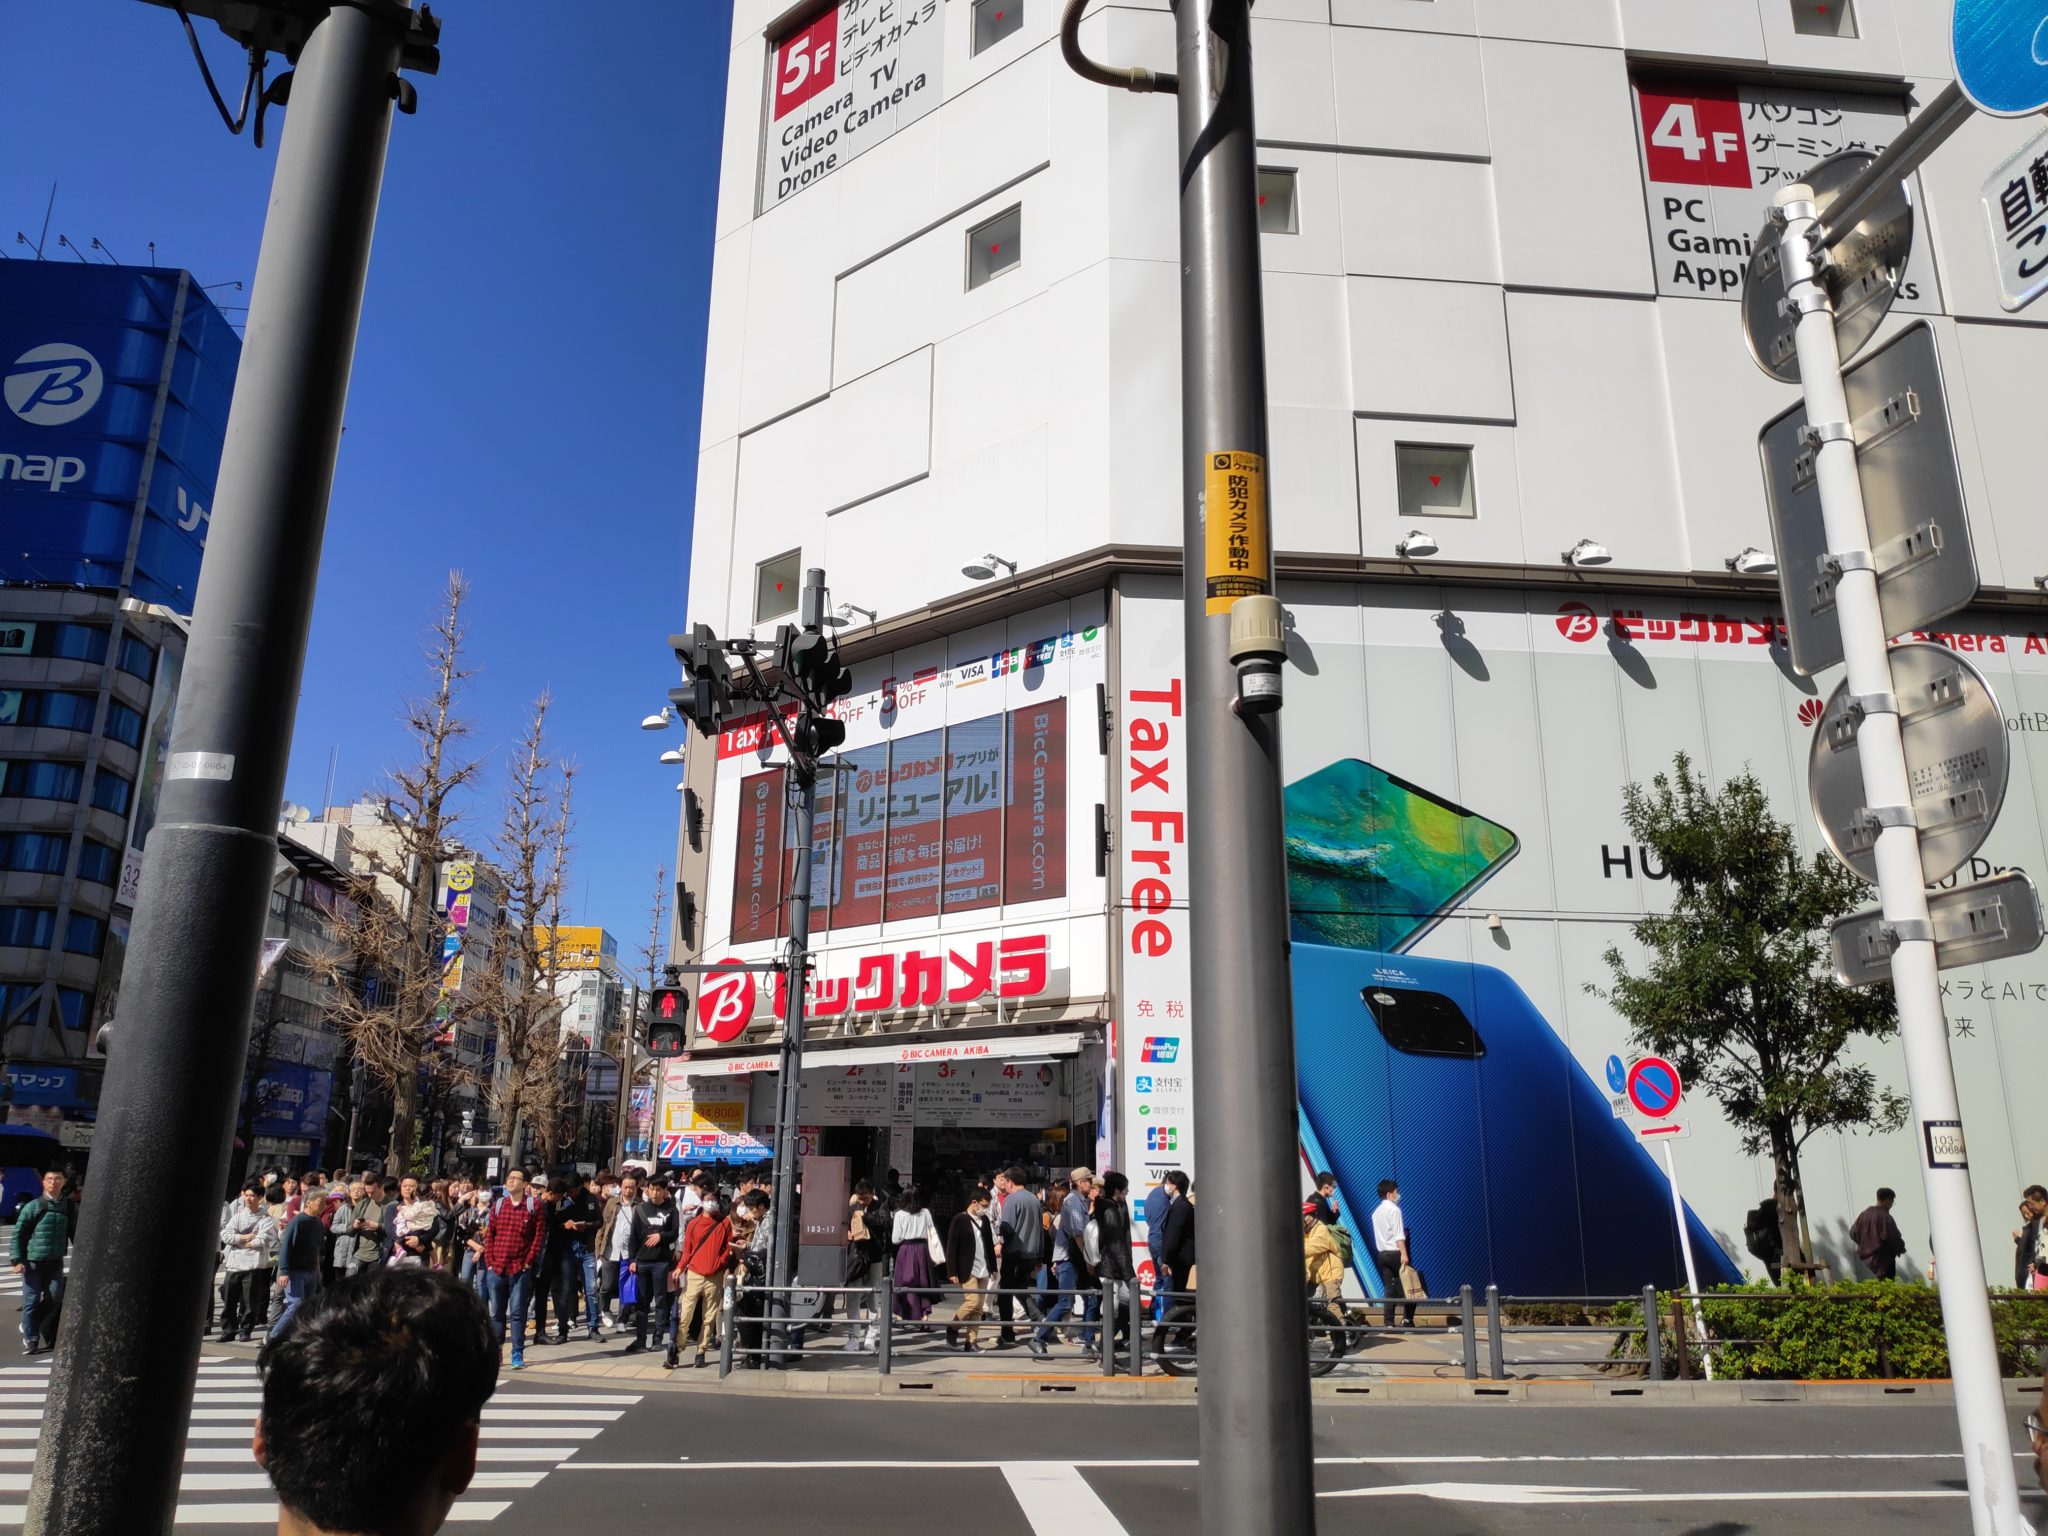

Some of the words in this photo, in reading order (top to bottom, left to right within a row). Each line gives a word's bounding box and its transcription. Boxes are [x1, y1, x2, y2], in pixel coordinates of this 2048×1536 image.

[840, 1, 936, 77] ビデオカメラ
[843, 1, 894, 48] テレビ
[781, 36, 831, 96] 5F
[781, 91, 854, 146] Camera
[870, 58, 897, 90] TV
[1747, 102, 1842, 127] パソコン
[781, 128, 838, 173] Video
[843, 73, 926, 134] Camera
[1651, 103, 1739, 163] 4F
[778, 153, 837, 200] Drone
[1664, 198, 1705, 223] PC
[1668, 229, 1757, 256] Gami
[1673, 260, 1745, 292] Appl
[1228, 474, 1249, 571] 防犯カメラ作動中
[960, 664, 984, 680] VISA
[898, 690, 927, 709] OFF
[1129, 678, 1182, 794] Tax
[2007, 712, 2048, 732] oftB
[1131, 810, 1184, 957] Free
[1945, 1016, 1976, 1038] 来
[734, 1063, 744, 1071] BIC
[746, 1061, 774, 1070] CAMERA
[909, 1049, 923, 1059] BIC
[924, 1048, 958, 1059] CAMERA
[964, 1046, 990, 1056] AKIBA
[662, 1134, 689, 1157] 7F
[806, 1225, 836, 1233] 103-17
